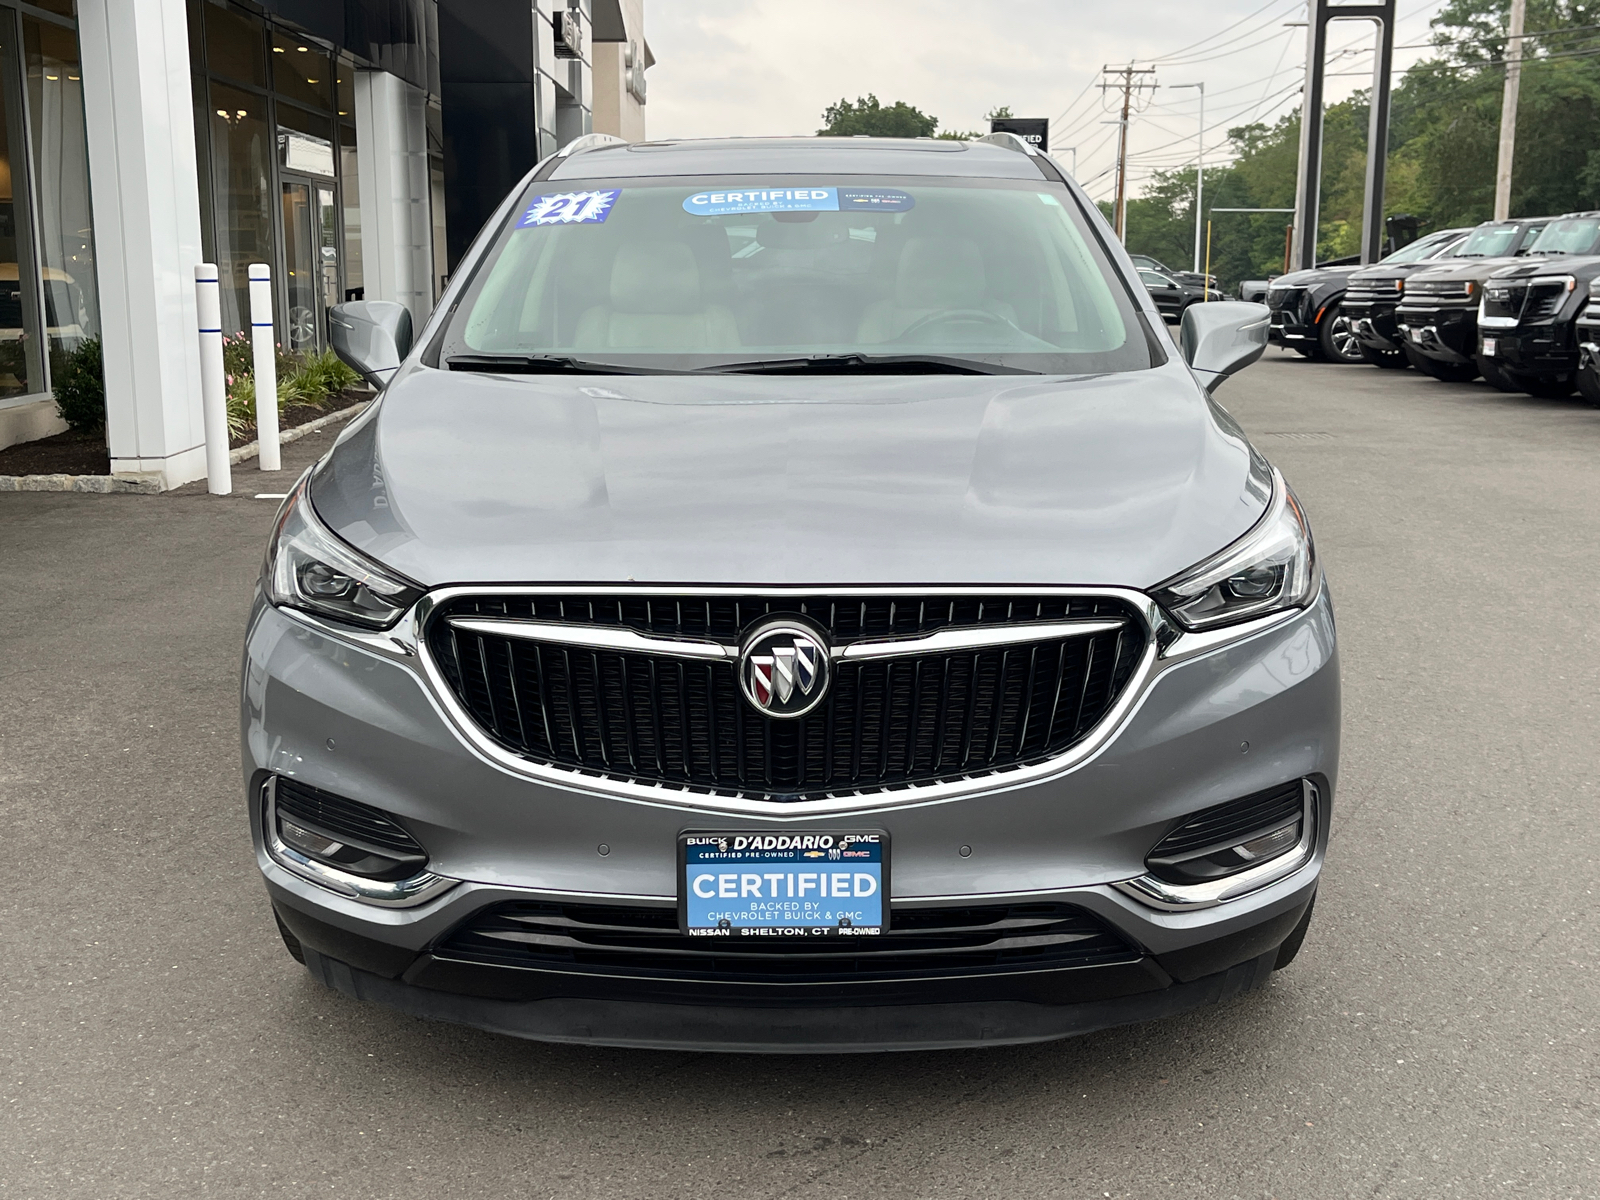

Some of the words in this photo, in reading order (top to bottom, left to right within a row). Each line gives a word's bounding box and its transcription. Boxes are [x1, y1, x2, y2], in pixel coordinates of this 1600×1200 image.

[692, 190, 829, 205] CERTIFIED
[541, 196, 593, 218] 21
[686, 837, 728, 845] BUICK
[733, 835, 834, 850] D'ADDARIO
[844, 835, 880, 843] GMC
[843, 850, 871, 858] GMC
[692, 873, 877, 899] CERTIFIED
[750, 902, 800, 911] BACKED
[804, 901, 820, 911] BY
[707, 911, 780, 921] CHEVROLET
[784, 911, 821, 920] BUICK
[824, 911, 833, 920] &
[836, 911, 863, 920] GMC
[688, 928, 730, 936] NISSAN
[740, 927, 808, 937] SHELTON,
[811, 927, 831, 936] CT
[838, 927, 881, 936] PRE-OWNED
